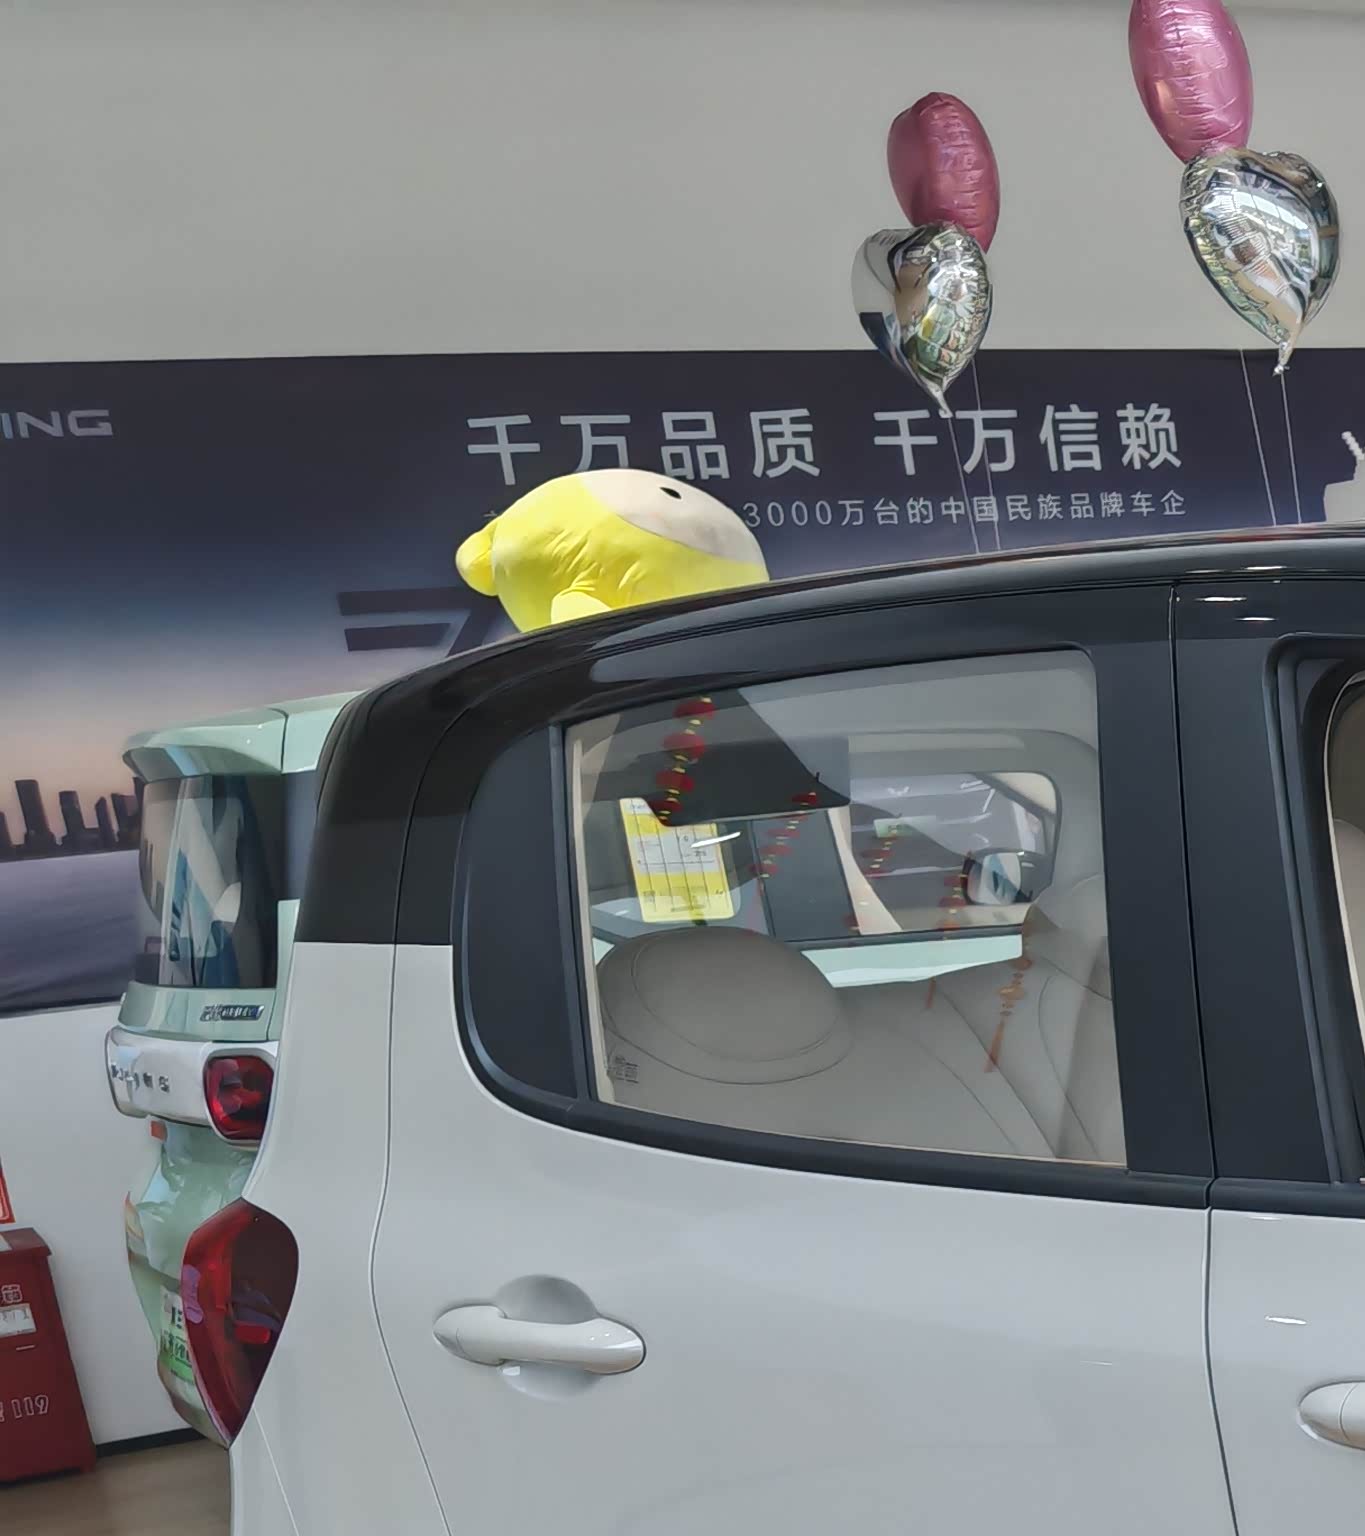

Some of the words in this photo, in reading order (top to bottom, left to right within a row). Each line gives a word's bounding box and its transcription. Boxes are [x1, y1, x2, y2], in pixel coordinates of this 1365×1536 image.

[466, 408, 821, 486] 千万品质
[873, 402, 1183, 477] 千万信赖
